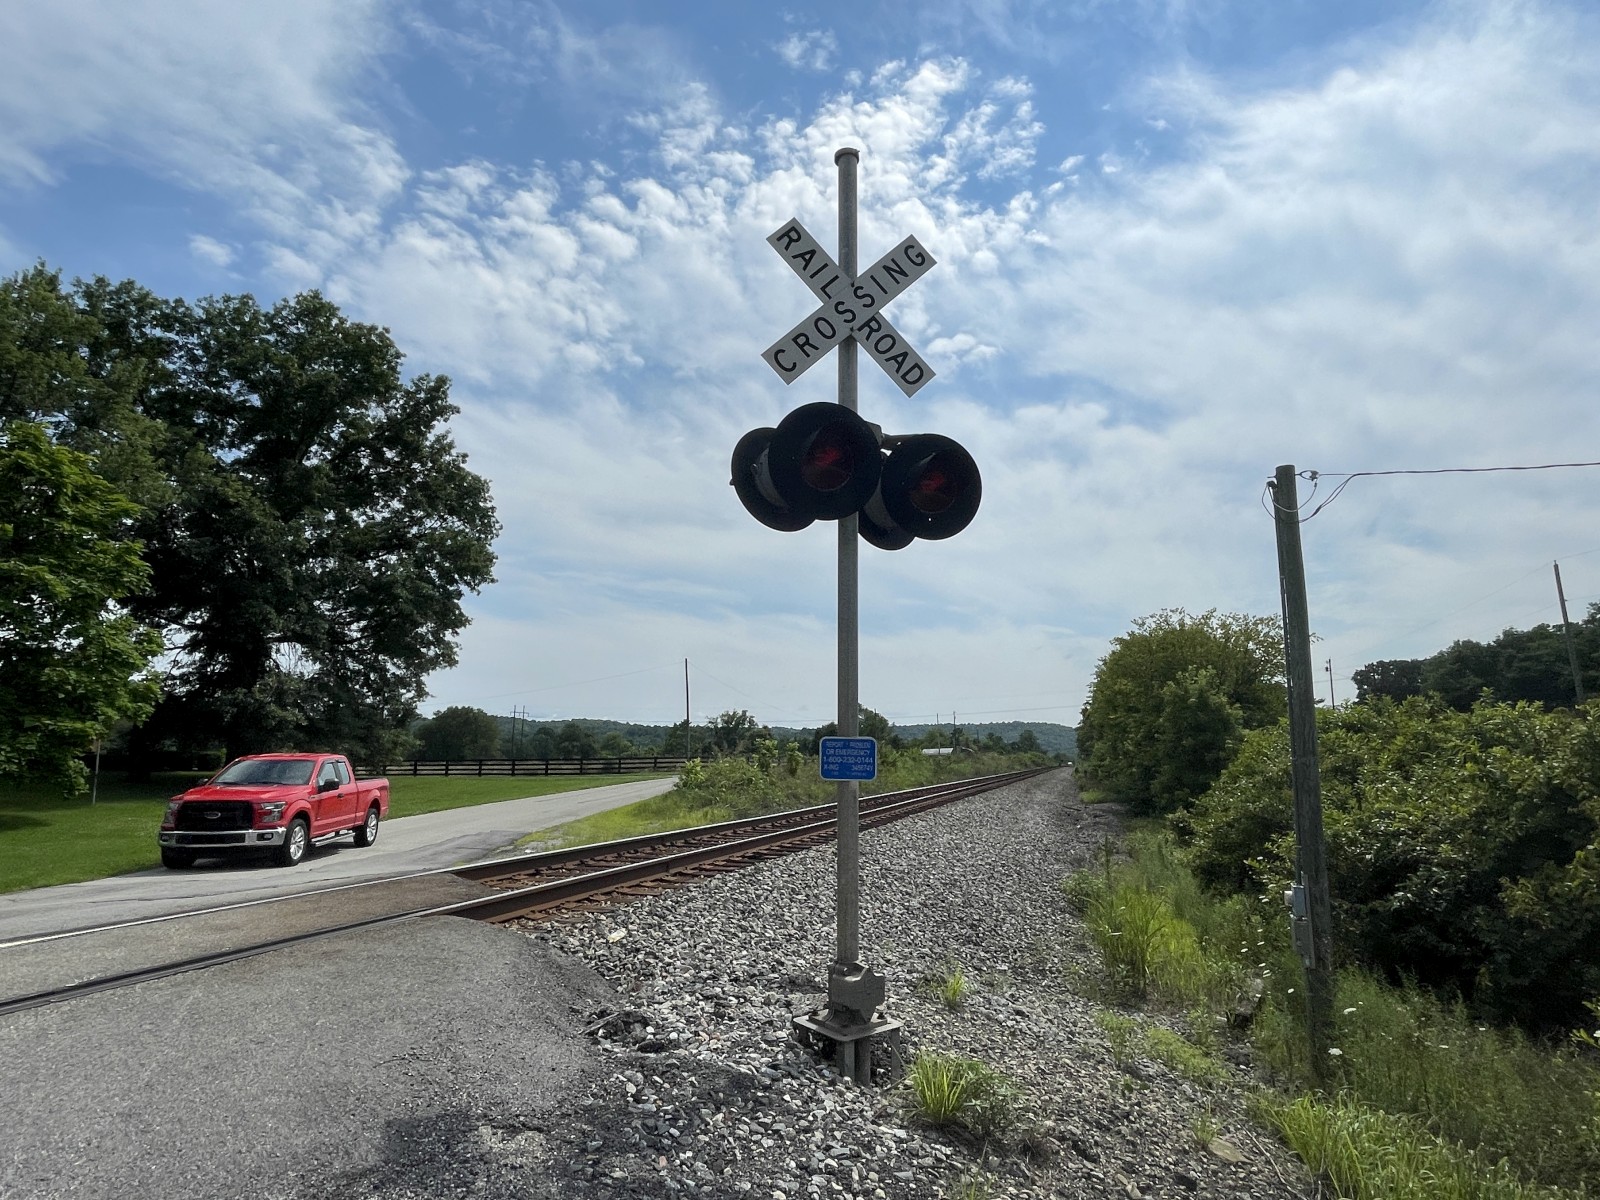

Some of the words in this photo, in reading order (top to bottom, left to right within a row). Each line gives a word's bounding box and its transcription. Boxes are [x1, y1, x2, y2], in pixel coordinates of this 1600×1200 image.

[773, 244, 926, 372] CROSSING
[776, 226, 840, 300] RAIL
[857, 315, 924, 385] ROAD
